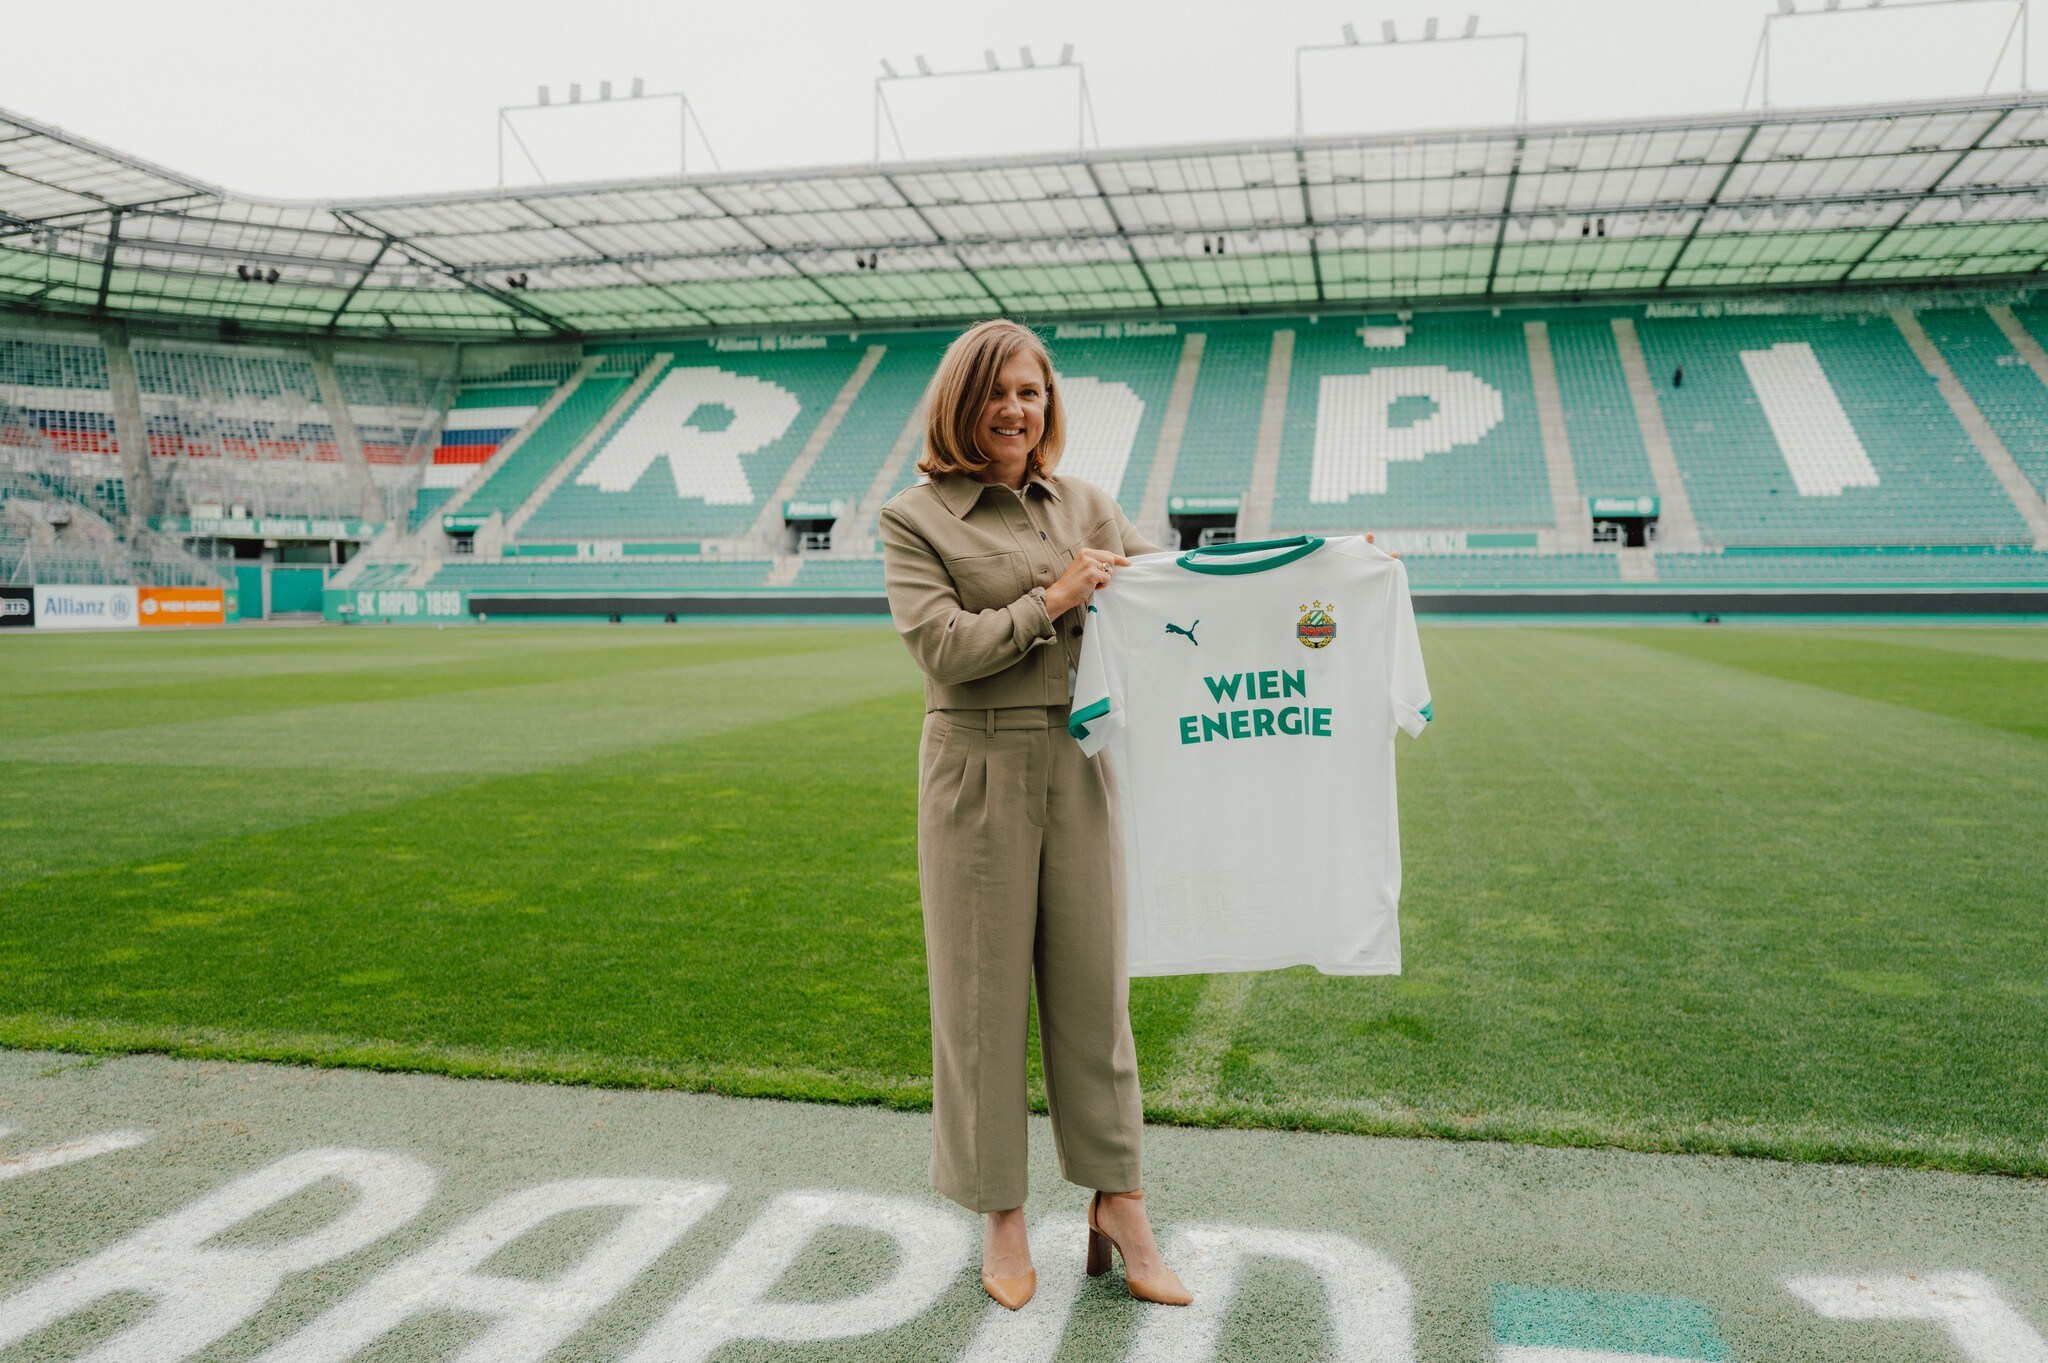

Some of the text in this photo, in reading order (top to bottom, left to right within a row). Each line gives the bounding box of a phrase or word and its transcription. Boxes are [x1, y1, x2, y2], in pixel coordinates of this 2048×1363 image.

[1645, 302, 1698, 318] Allianz
[1054, 321, 1177, 339] Allianz Stadion
[715, 334, 827, 352] Allianz Stadion
[786, 501, 827, 516] Allianz
[1594, 498, 1635, 512] Allianz
[44, 597, 105, 617] Allianz
[357, 590, 461, 616] SK RAPID 1899
[1299, 625, 1334, 636] RAPID
[1203, 669, 1306, 704] WIEN
[1179, 706, 1333, 745] ENERGIE
